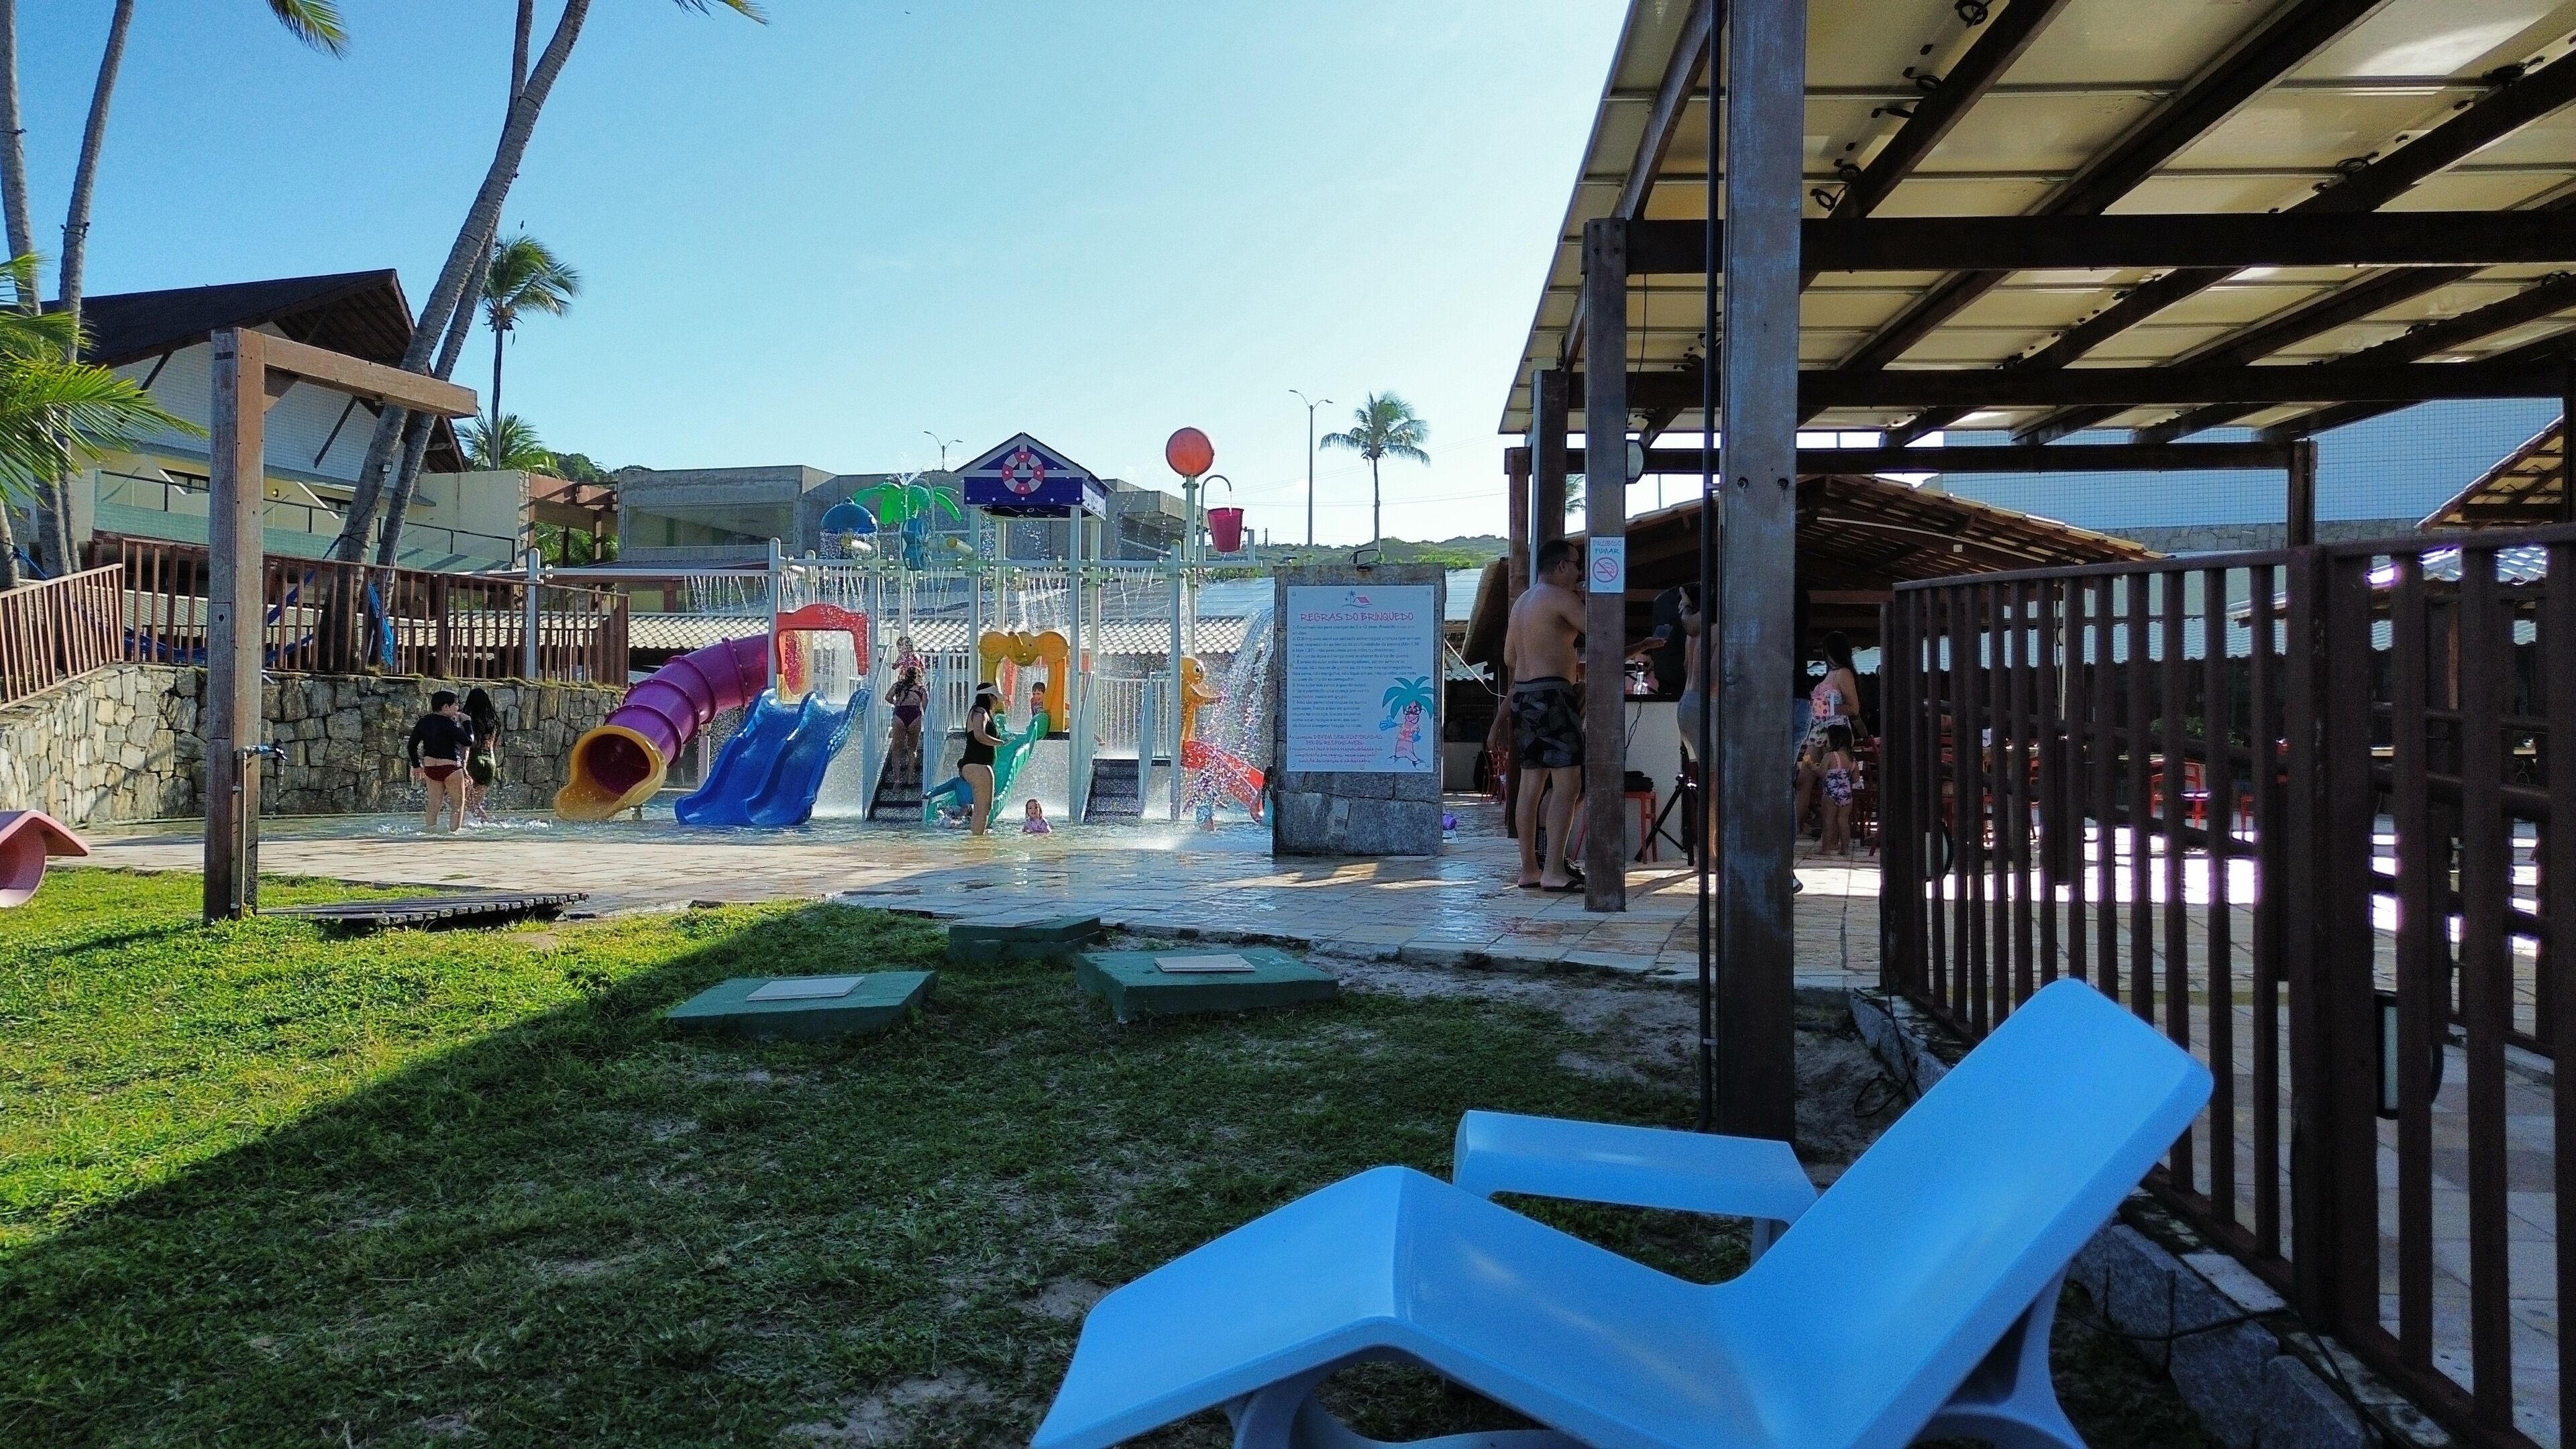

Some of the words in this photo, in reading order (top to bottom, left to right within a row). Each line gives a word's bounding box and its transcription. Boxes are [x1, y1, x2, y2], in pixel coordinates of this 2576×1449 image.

[1299, 612, 1343, 621] REGRAS
[1344, 612, 1358, 621] DO
[1360, 611, 1414, 621] BRINQUEDO
